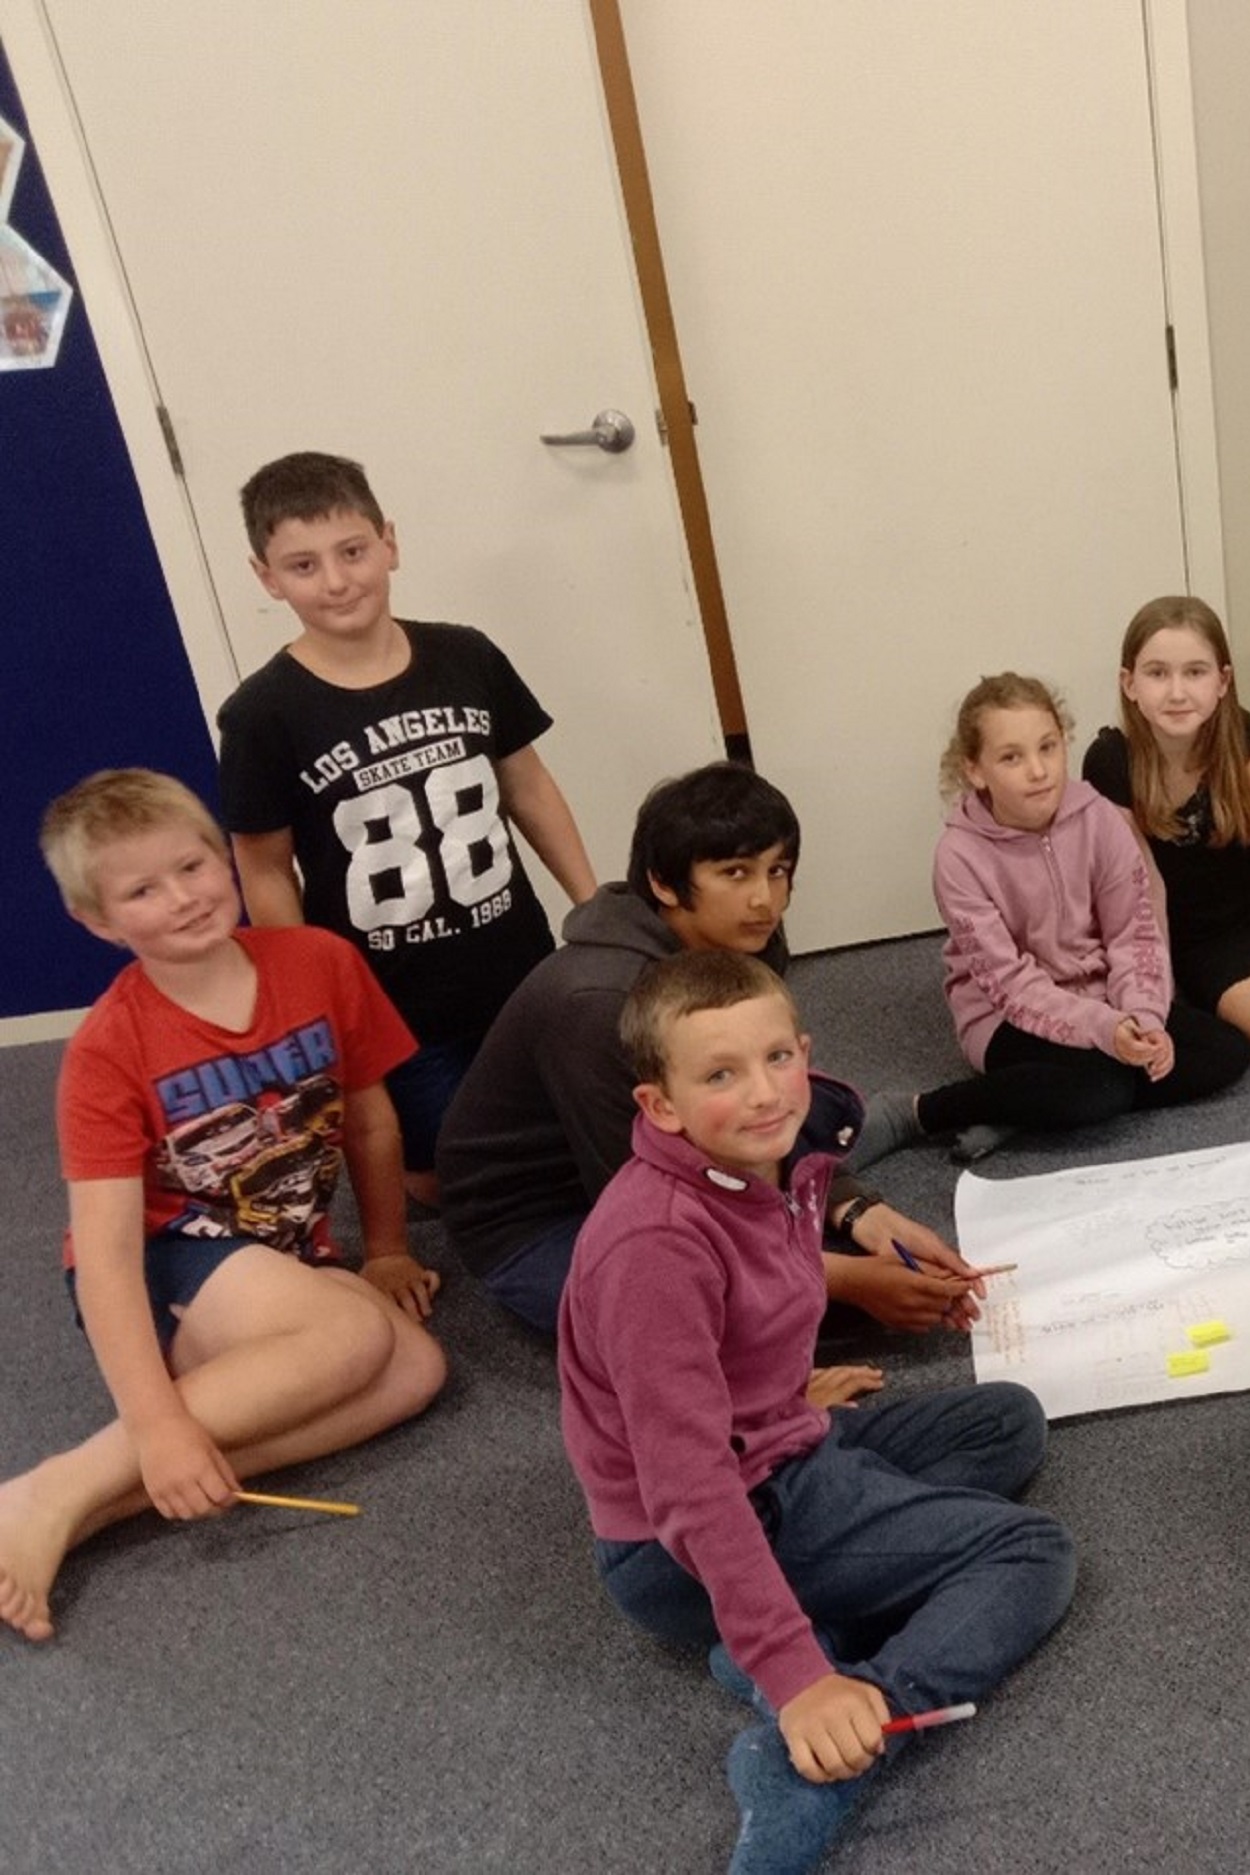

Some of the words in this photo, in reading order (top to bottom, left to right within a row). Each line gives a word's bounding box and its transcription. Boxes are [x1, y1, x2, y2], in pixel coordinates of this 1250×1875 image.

[300, 741, 360, 794] LOS
[363, 706, 491, 754] ANGELES
[358, 758, 409, 788] SKATE
[413, 740, 464, 768] TEAM
[332, 753, 513, 932] 88
[368, 929, 395, 950] SO
[406, 917, 460, 943] CAL.
